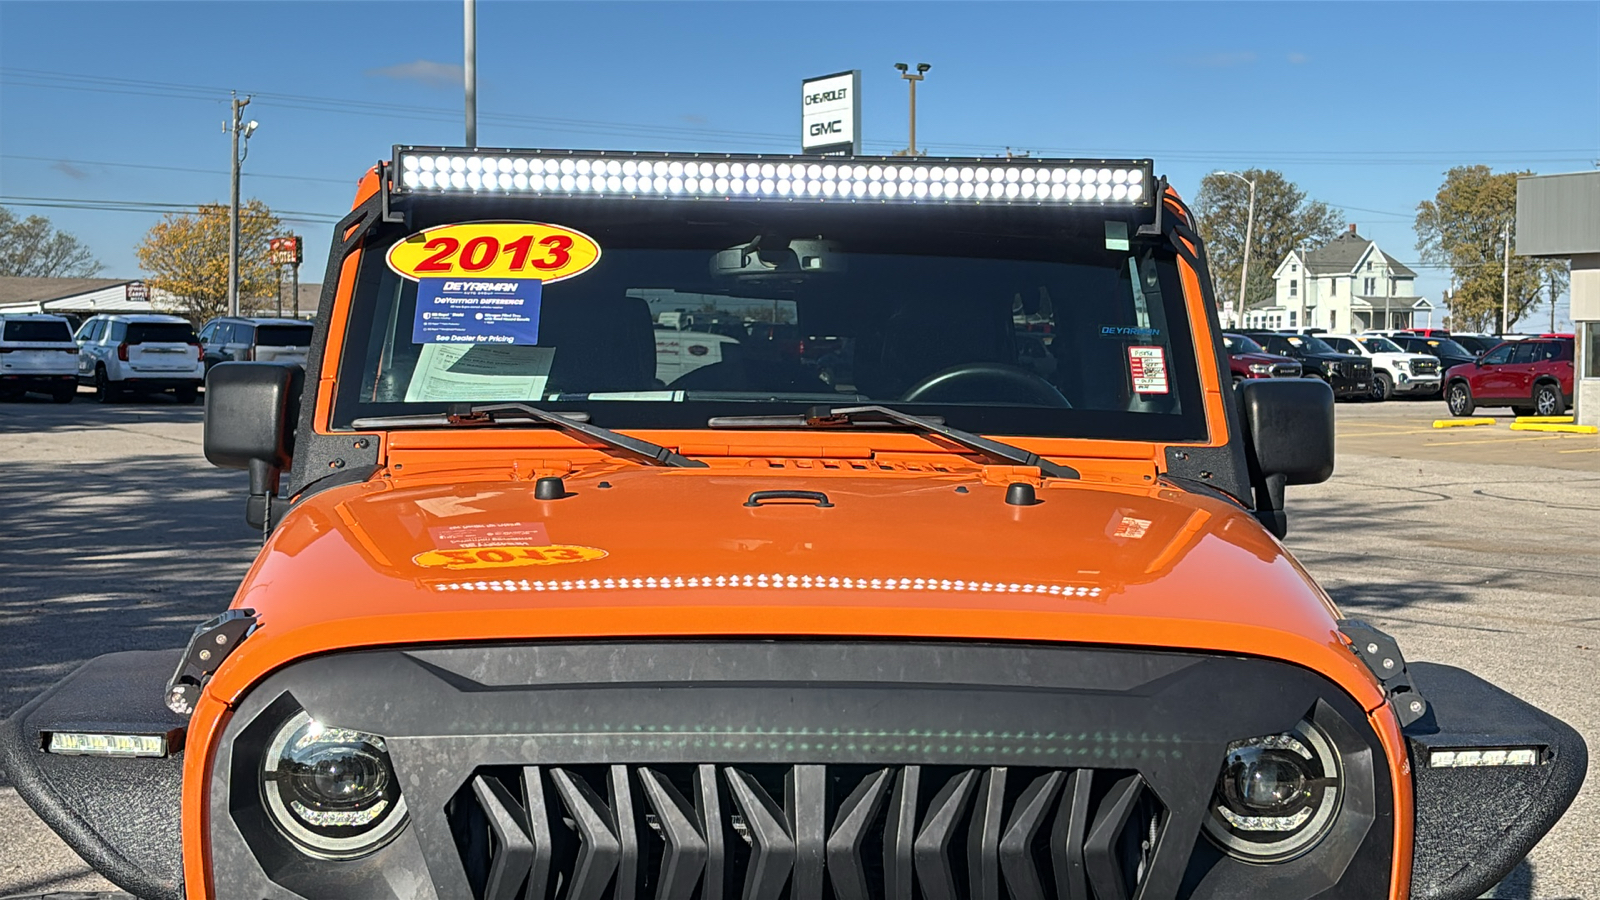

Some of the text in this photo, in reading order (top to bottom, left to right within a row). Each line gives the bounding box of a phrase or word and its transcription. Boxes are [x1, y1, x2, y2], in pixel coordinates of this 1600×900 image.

[805, 88, 847, 106] CHEVROLET
[810, 120, 842, 136] GMC
[413, 235, 574, 273] 2013
[443, 281, 519, 292] DEYARMAN
[434, 296, 525, 306] DeYarman DIFFERENCE
[1101, 326, 1161, 336] DEYARMAN
[488, 335, 514, 344] Pricing
